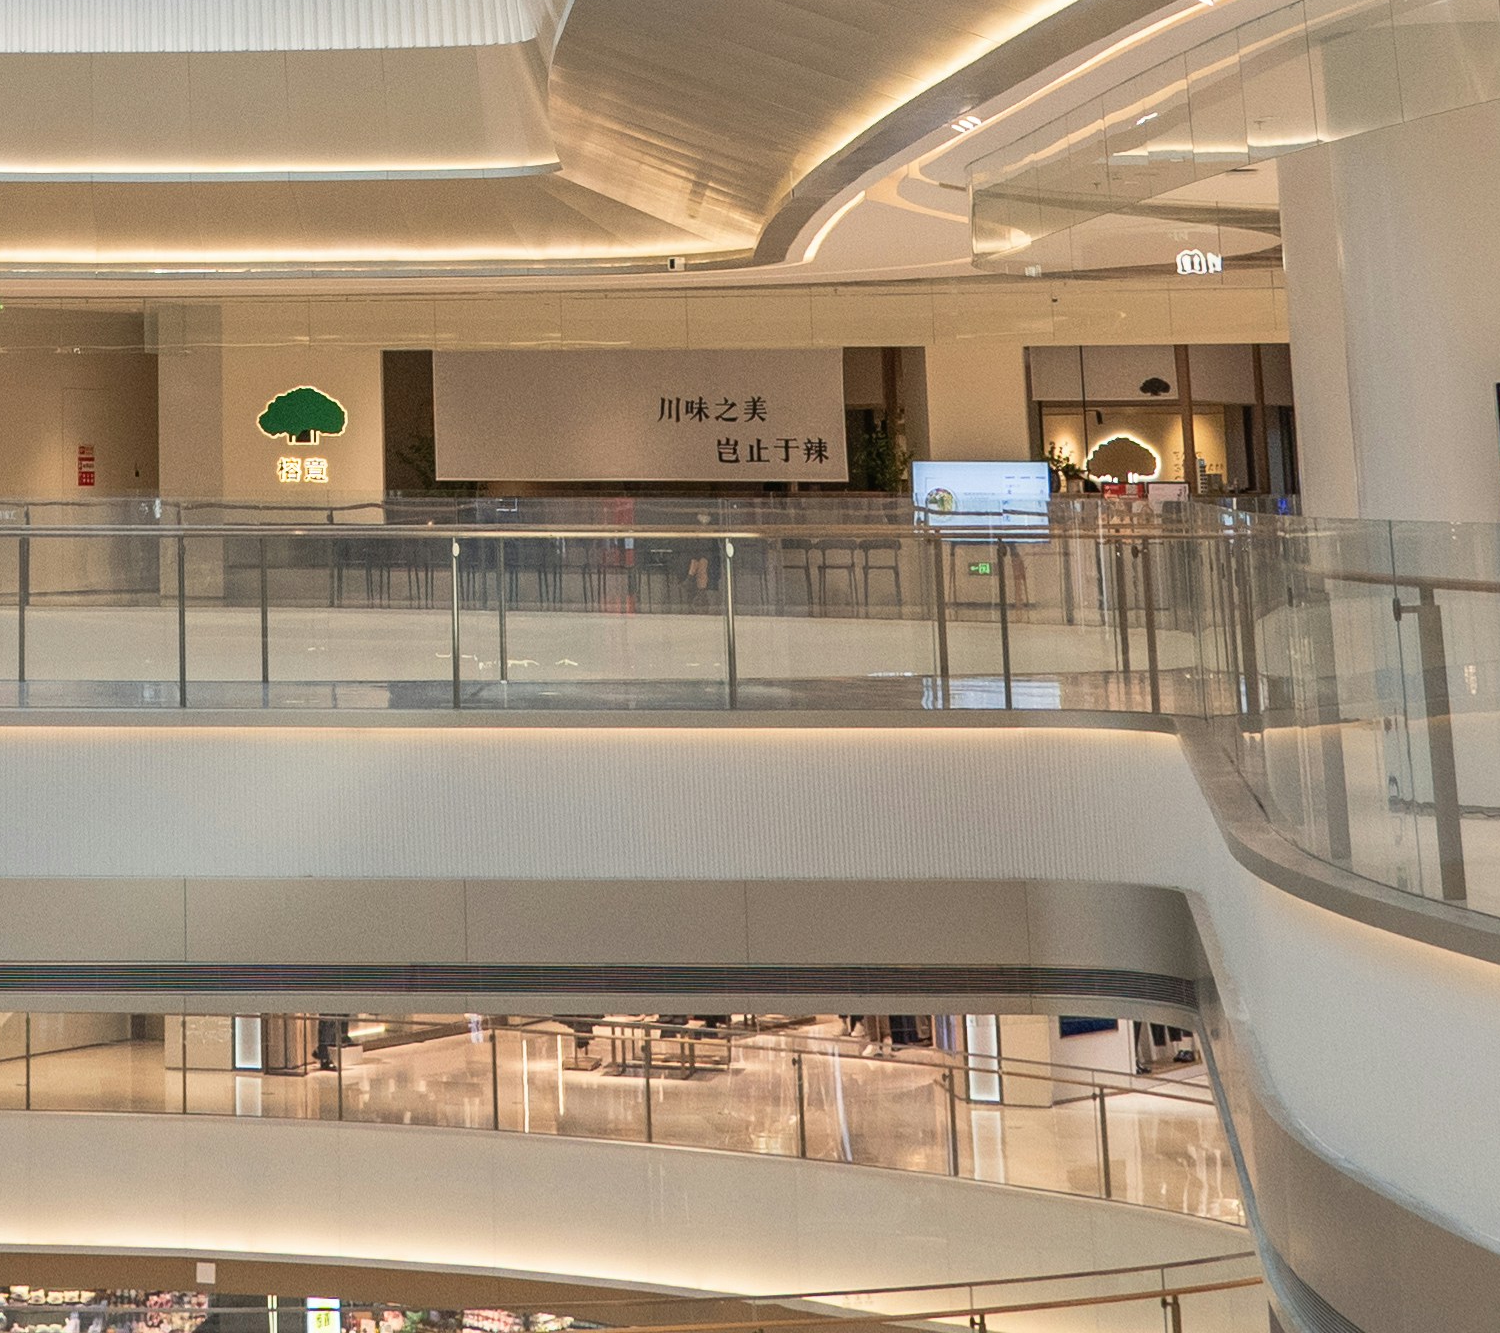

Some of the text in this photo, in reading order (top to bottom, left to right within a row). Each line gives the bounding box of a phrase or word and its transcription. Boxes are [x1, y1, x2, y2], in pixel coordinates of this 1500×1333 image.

[657, 396, 767, 423] 川味之美
[717, 437, 829, 464] 岂止于辣
